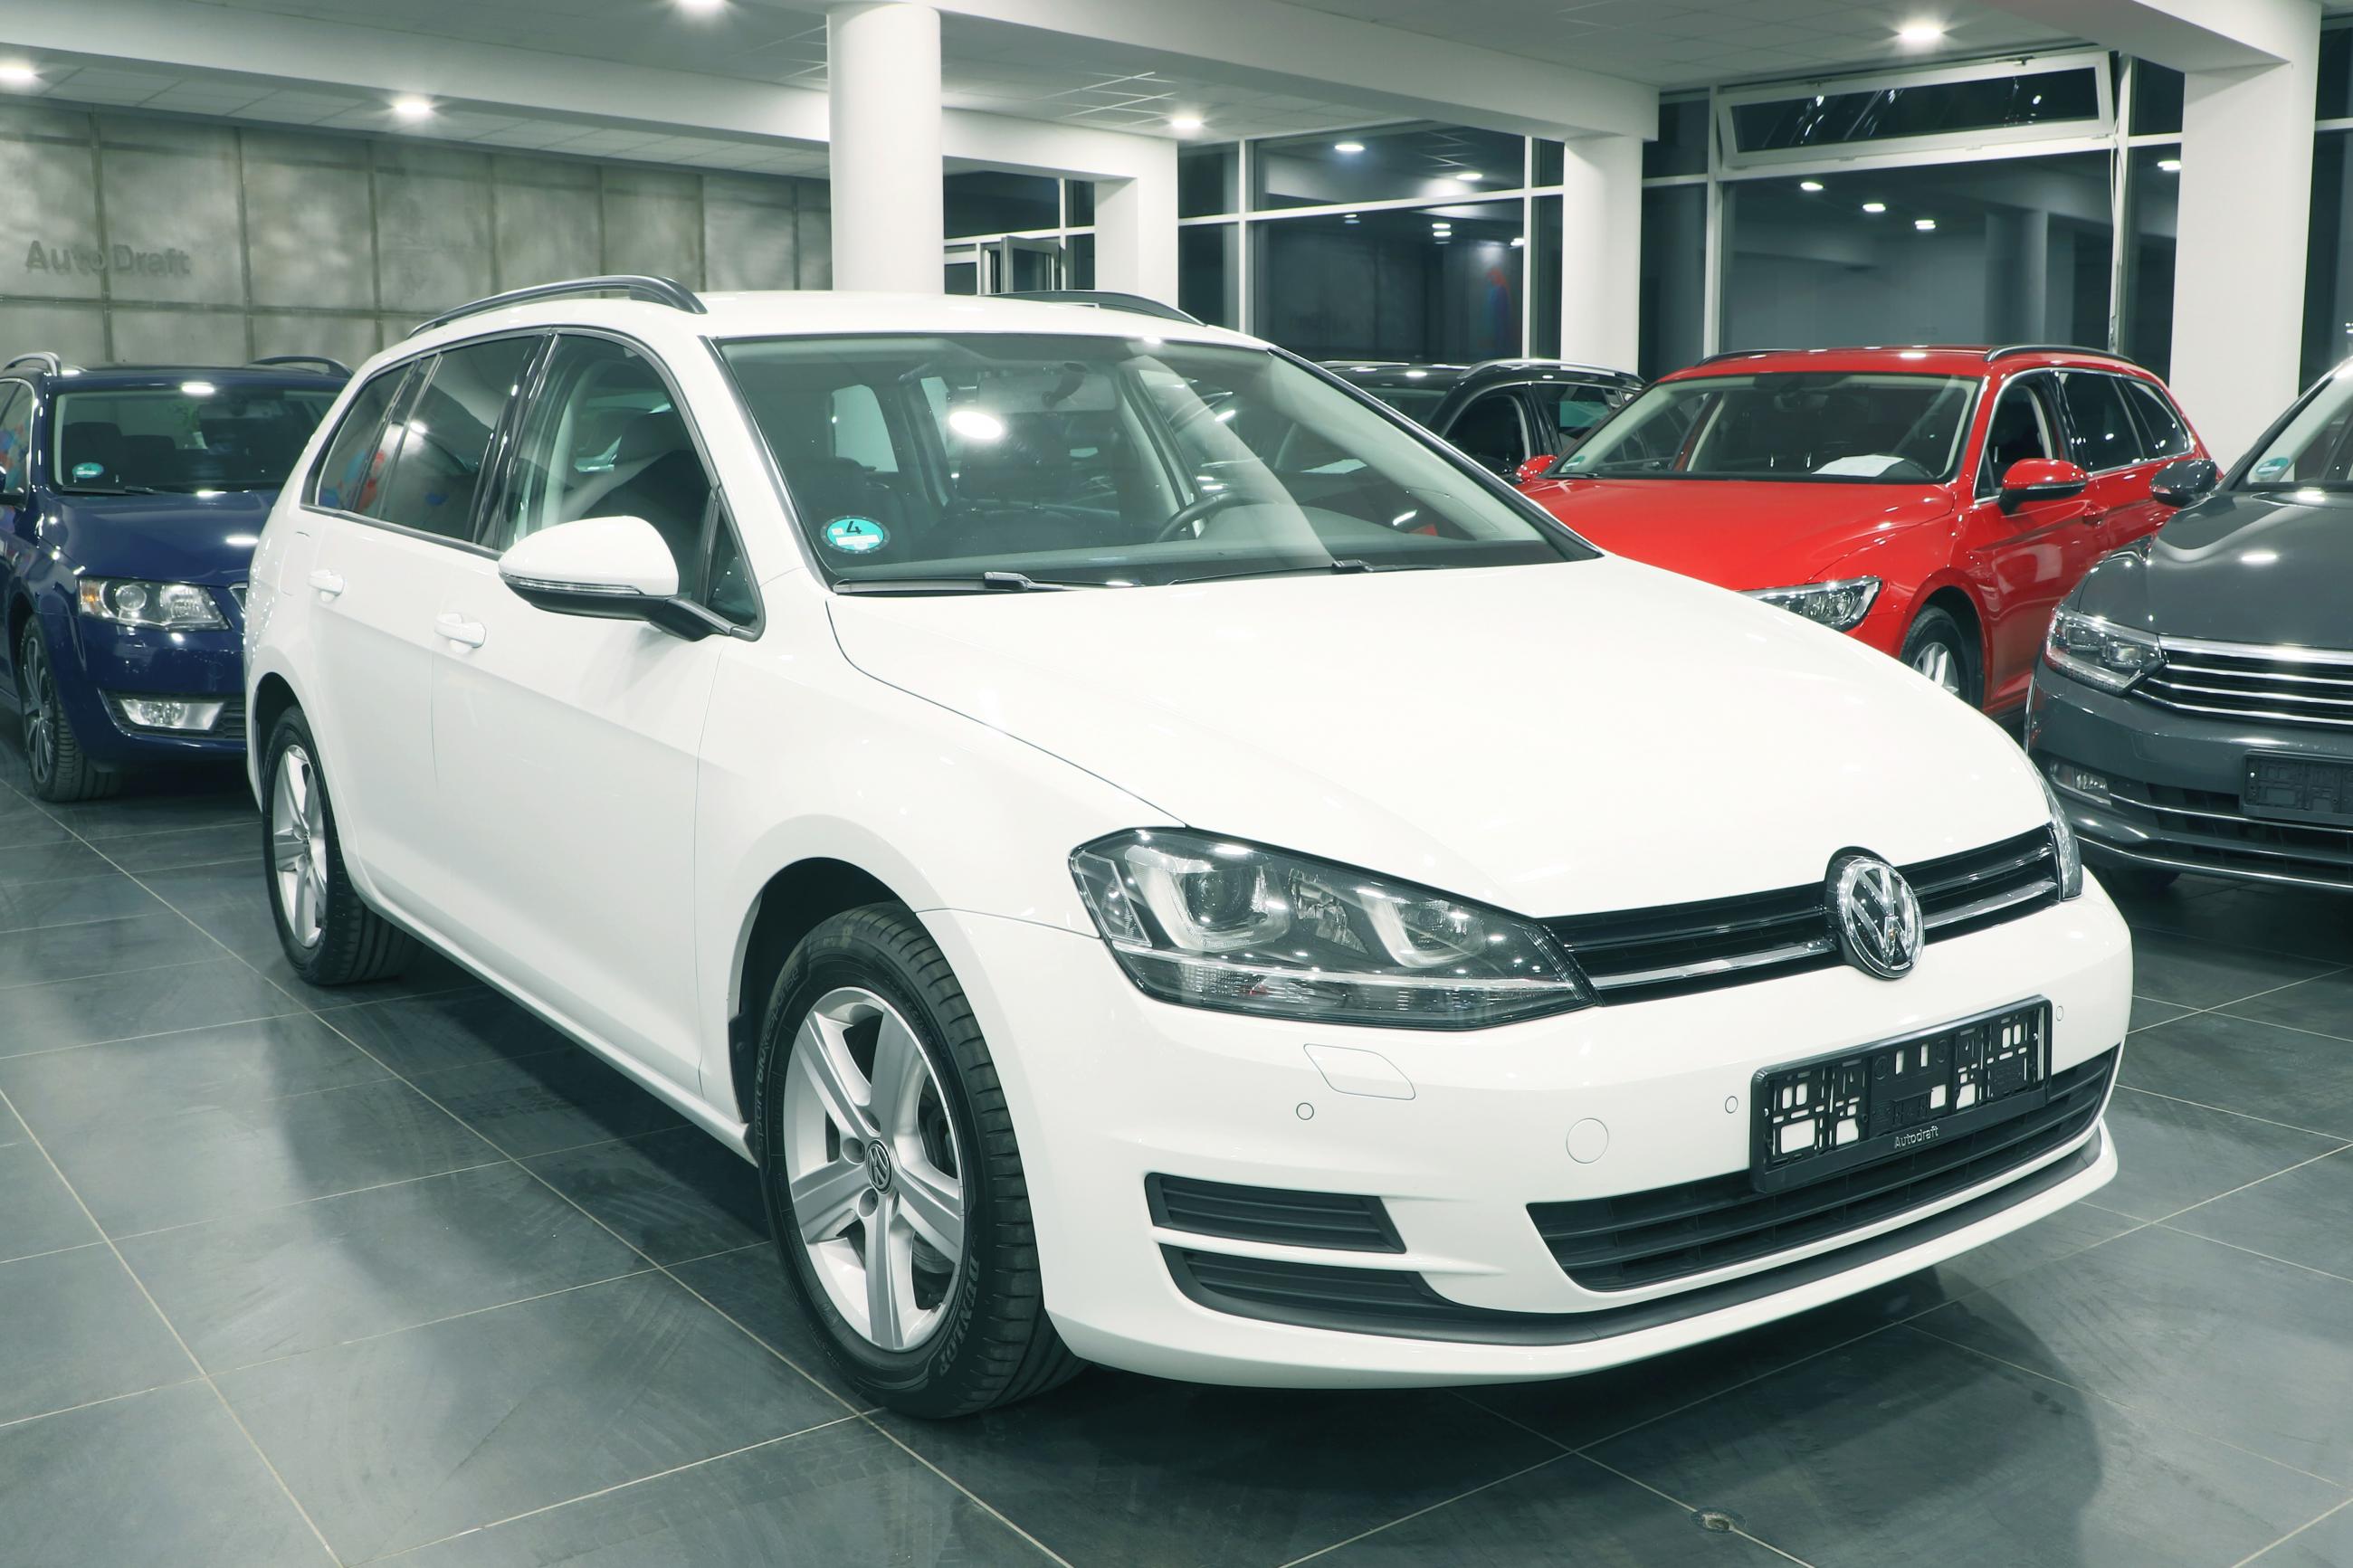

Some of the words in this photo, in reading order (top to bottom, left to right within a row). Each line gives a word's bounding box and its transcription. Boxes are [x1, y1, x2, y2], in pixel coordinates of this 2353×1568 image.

[25, 239, 107, 273] Auto
[112, 243, 190, 275] Draft
[846, 520, 862, 534] 4
[1894, 1125, 1939, 1149] Autodraft
[938, 1254, 980, 1376] DUNLOP
